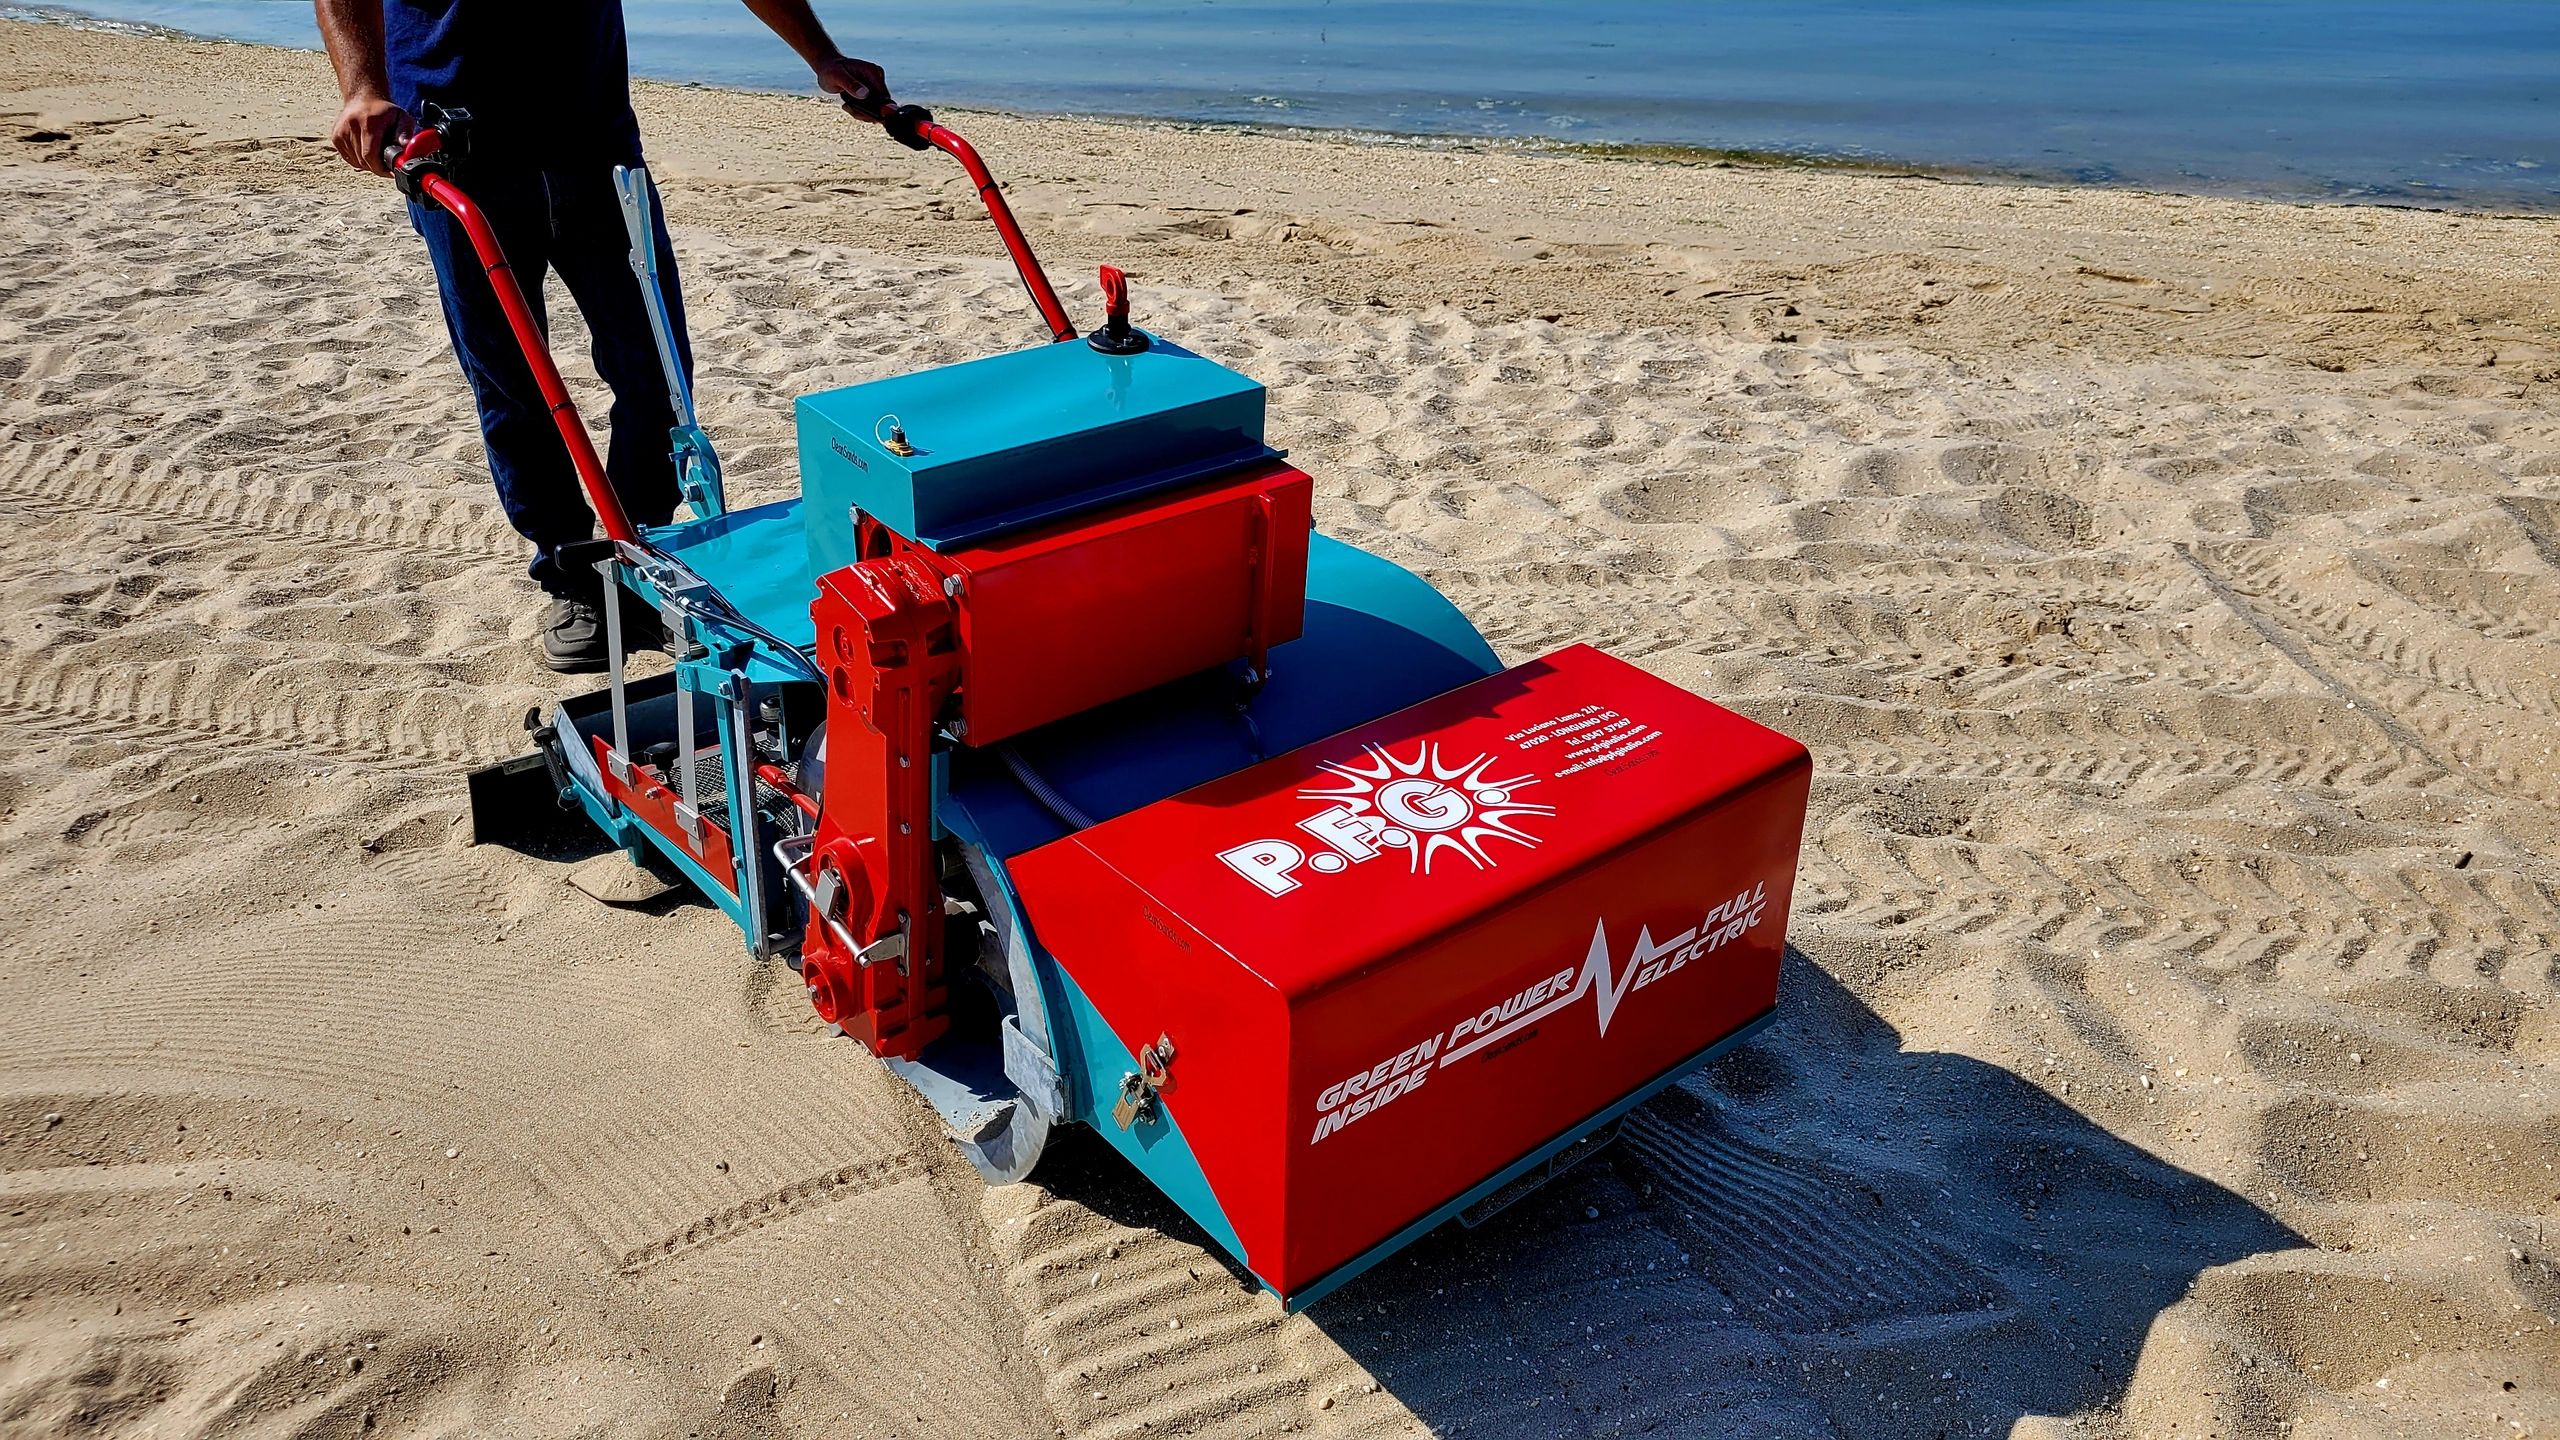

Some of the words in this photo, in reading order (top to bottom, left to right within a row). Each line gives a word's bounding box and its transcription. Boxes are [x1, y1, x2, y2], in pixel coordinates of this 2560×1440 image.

[1505, 732, 1525, 743] Via
[1522, 720, 1557, 735] Luciano
[1519, 735, 1549, 750] 47020
[1551, 717, 1600, 738] LONGIANO
[1597, 710, 1619, 721] (FC)
[1564, 724, 1648, 760] www.pfgitalia.com
[1565, 736, 1584, 747] Tel.
[1582, 729, 1605, 742] 0547
[1603, 717, 1631, 733] 57267
[1215, 778, 1510, 898] P.F.G.
[1701, 880, 1767, 933] FULL
[1632, 901, 1768, 992] ELECTRIC
[1316, 1032, 1443, 1112] GREEN
[1446, 966, 1574, 1049] POWER
[1310, 1063, 1434, 1145] INSIDE
